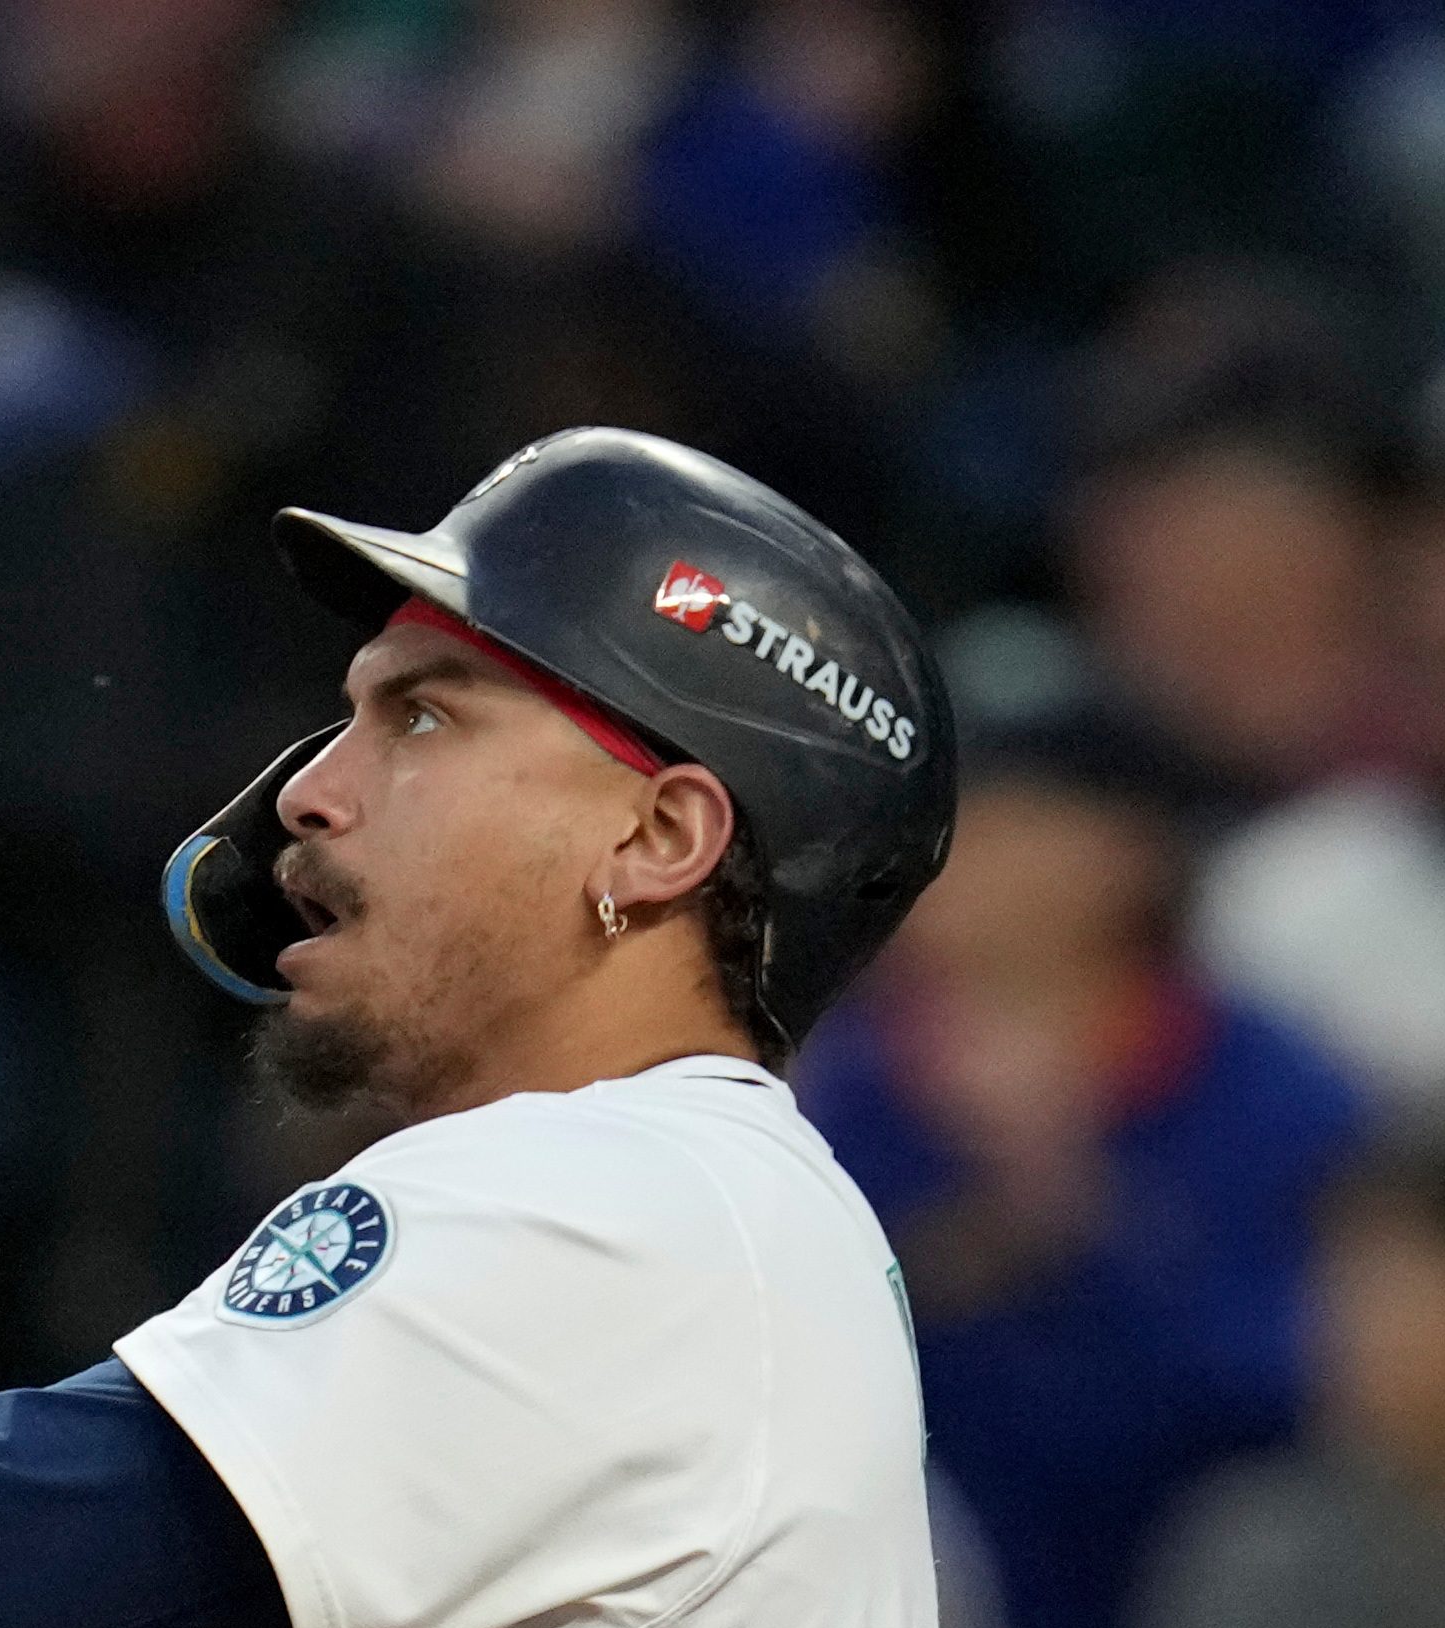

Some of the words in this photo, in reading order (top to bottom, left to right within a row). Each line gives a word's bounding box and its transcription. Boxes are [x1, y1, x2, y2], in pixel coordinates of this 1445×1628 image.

[721, 600, 916, 760] STRAUSS
[290, 1188, 381, 1272] SEATTLE
[227, 1246, 316, 1313] MARINERS
